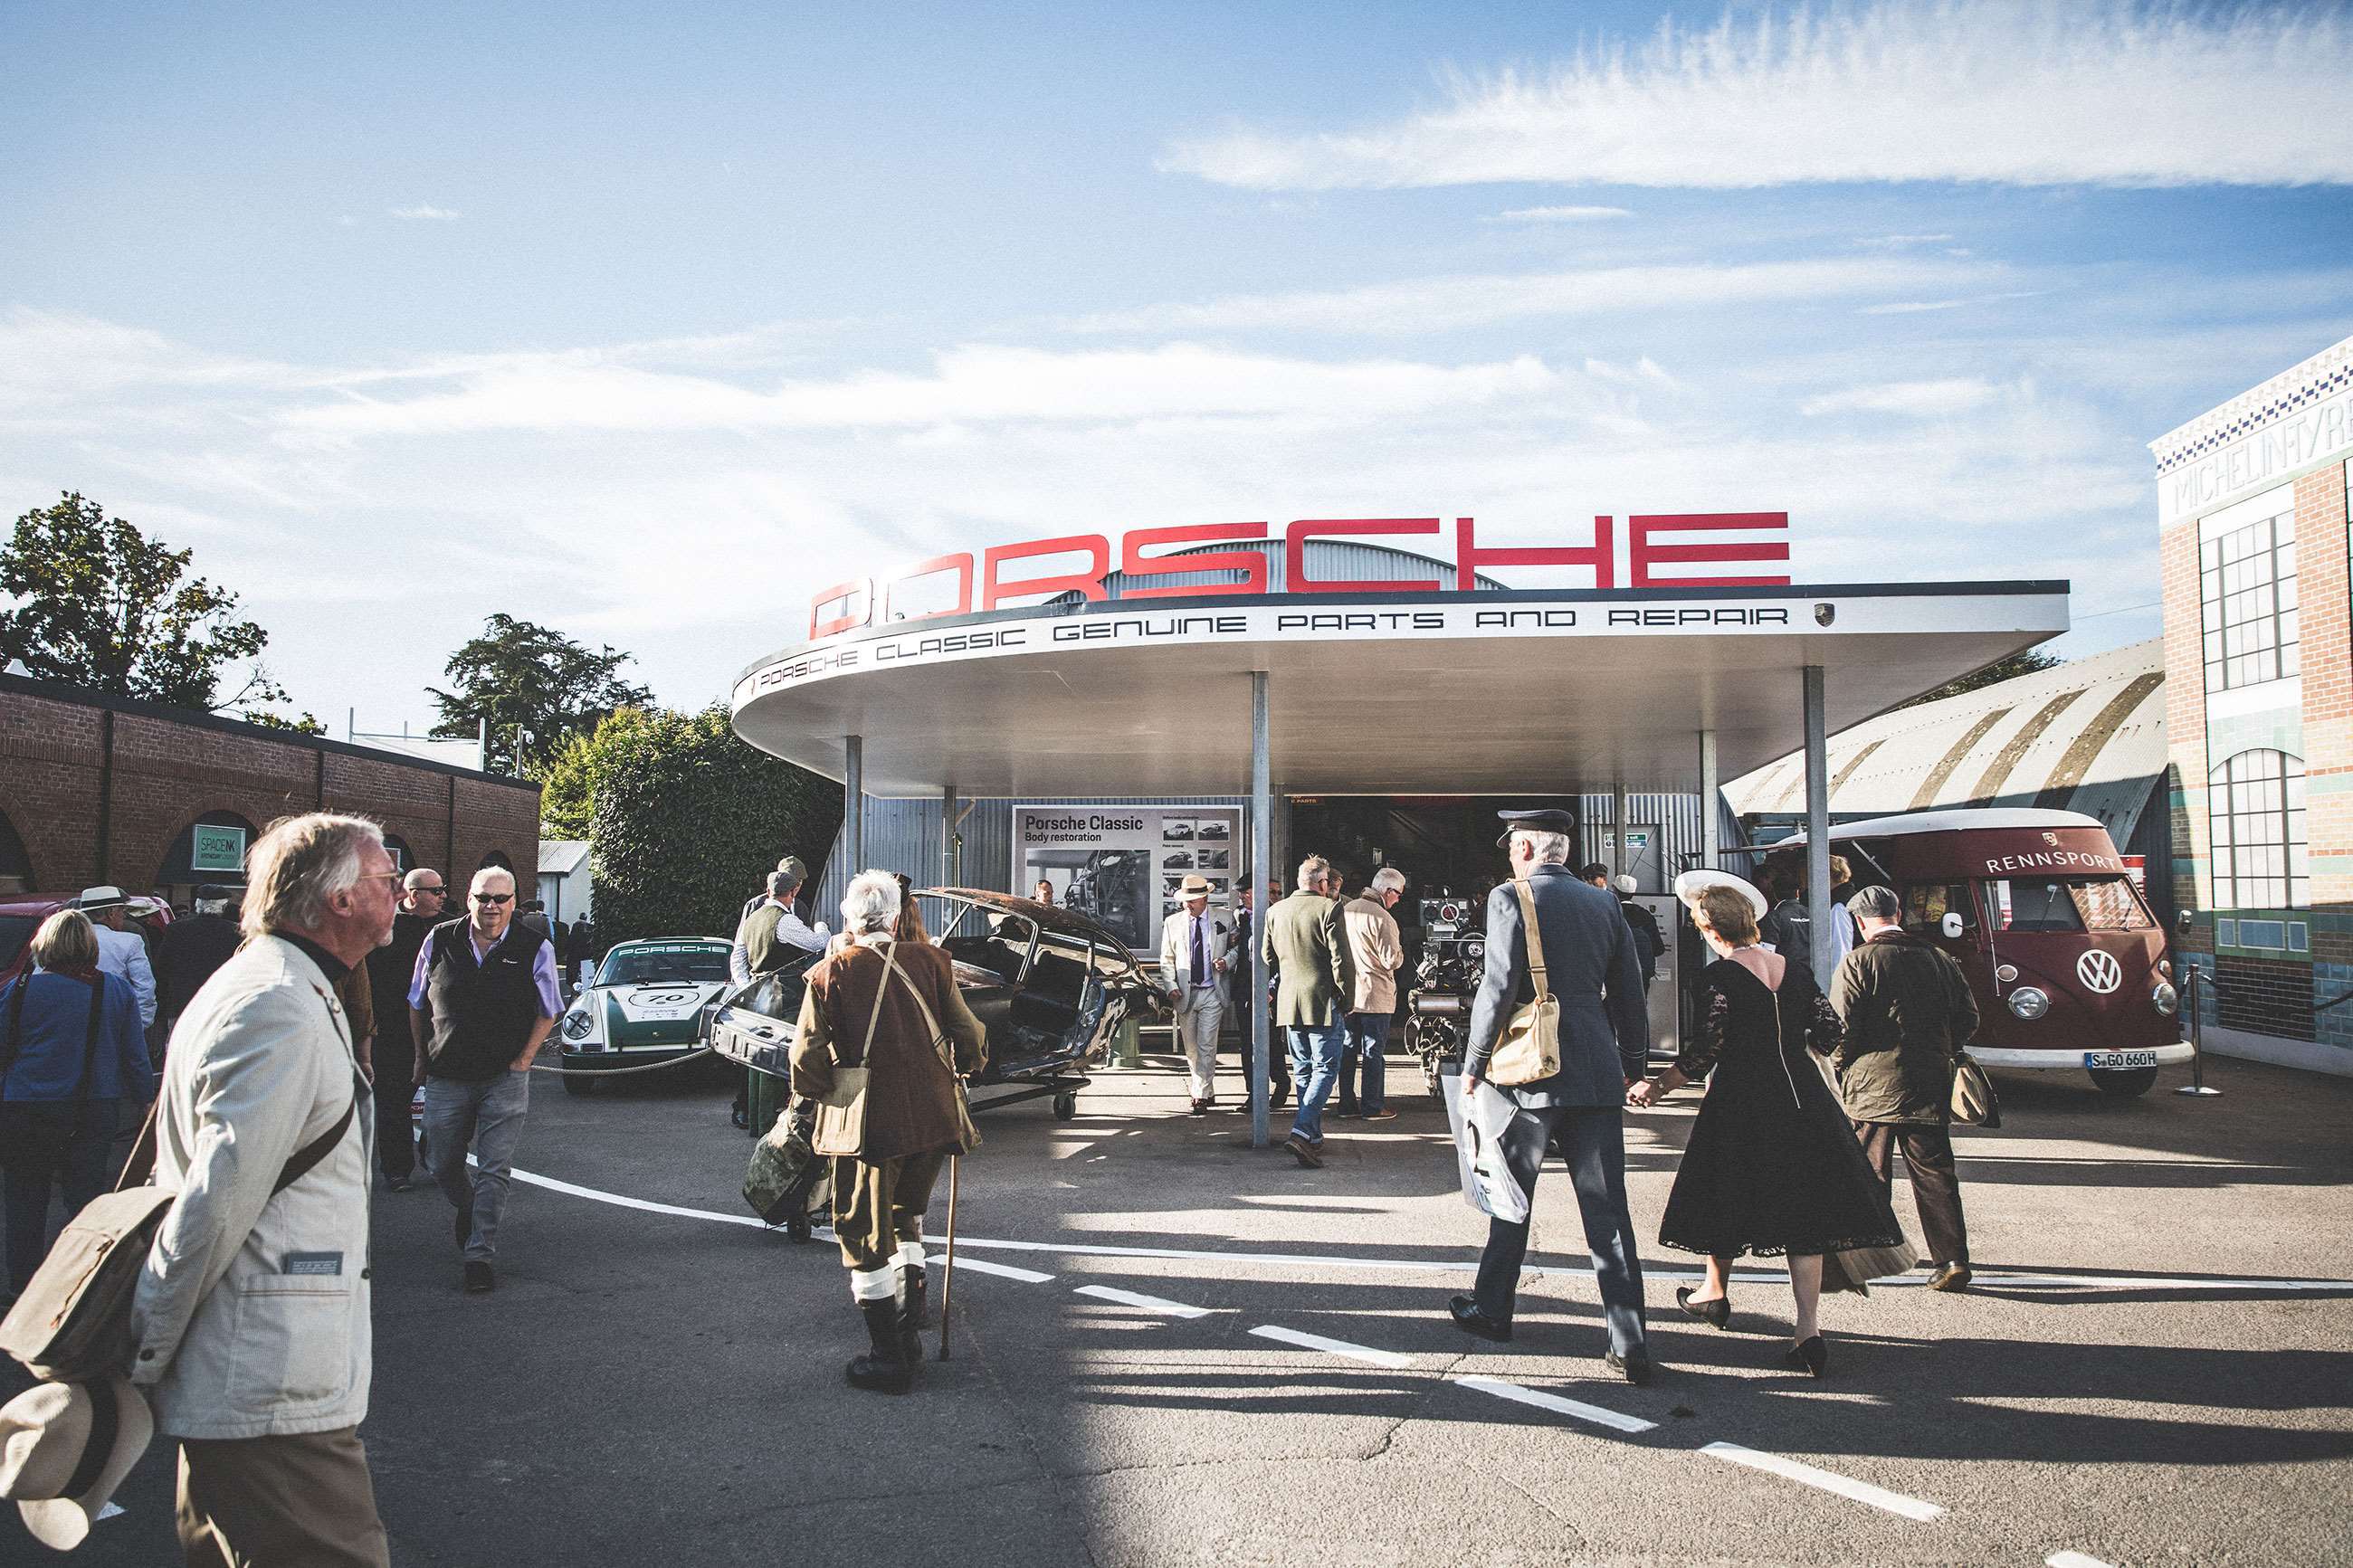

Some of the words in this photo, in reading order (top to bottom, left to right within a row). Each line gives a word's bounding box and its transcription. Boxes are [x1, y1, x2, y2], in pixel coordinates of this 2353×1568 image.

[809, 510, 1792, 640] PORSCHE
[759, 650, 859, 687] PORSCHE
[875, 629, 1026, 661] CLASSIC
[1052, 615, 1246, 642] GENUINE
[1277, 612, 1443, 632] PARTS
[1475, 609, 1577, 629] AND
[1608, 607, 1788, 627] REPAIR
[1025, 815, 1086, 831] Porsche
[1090, 815, 1143, 831] Classic
[1024, 832, 1049, 844] Body
[1051, 832, 1101, 842] restoration
[1986, 851, 2117, 874] RENNSPORT
[618, 946, 727, 956] PORSCHE
